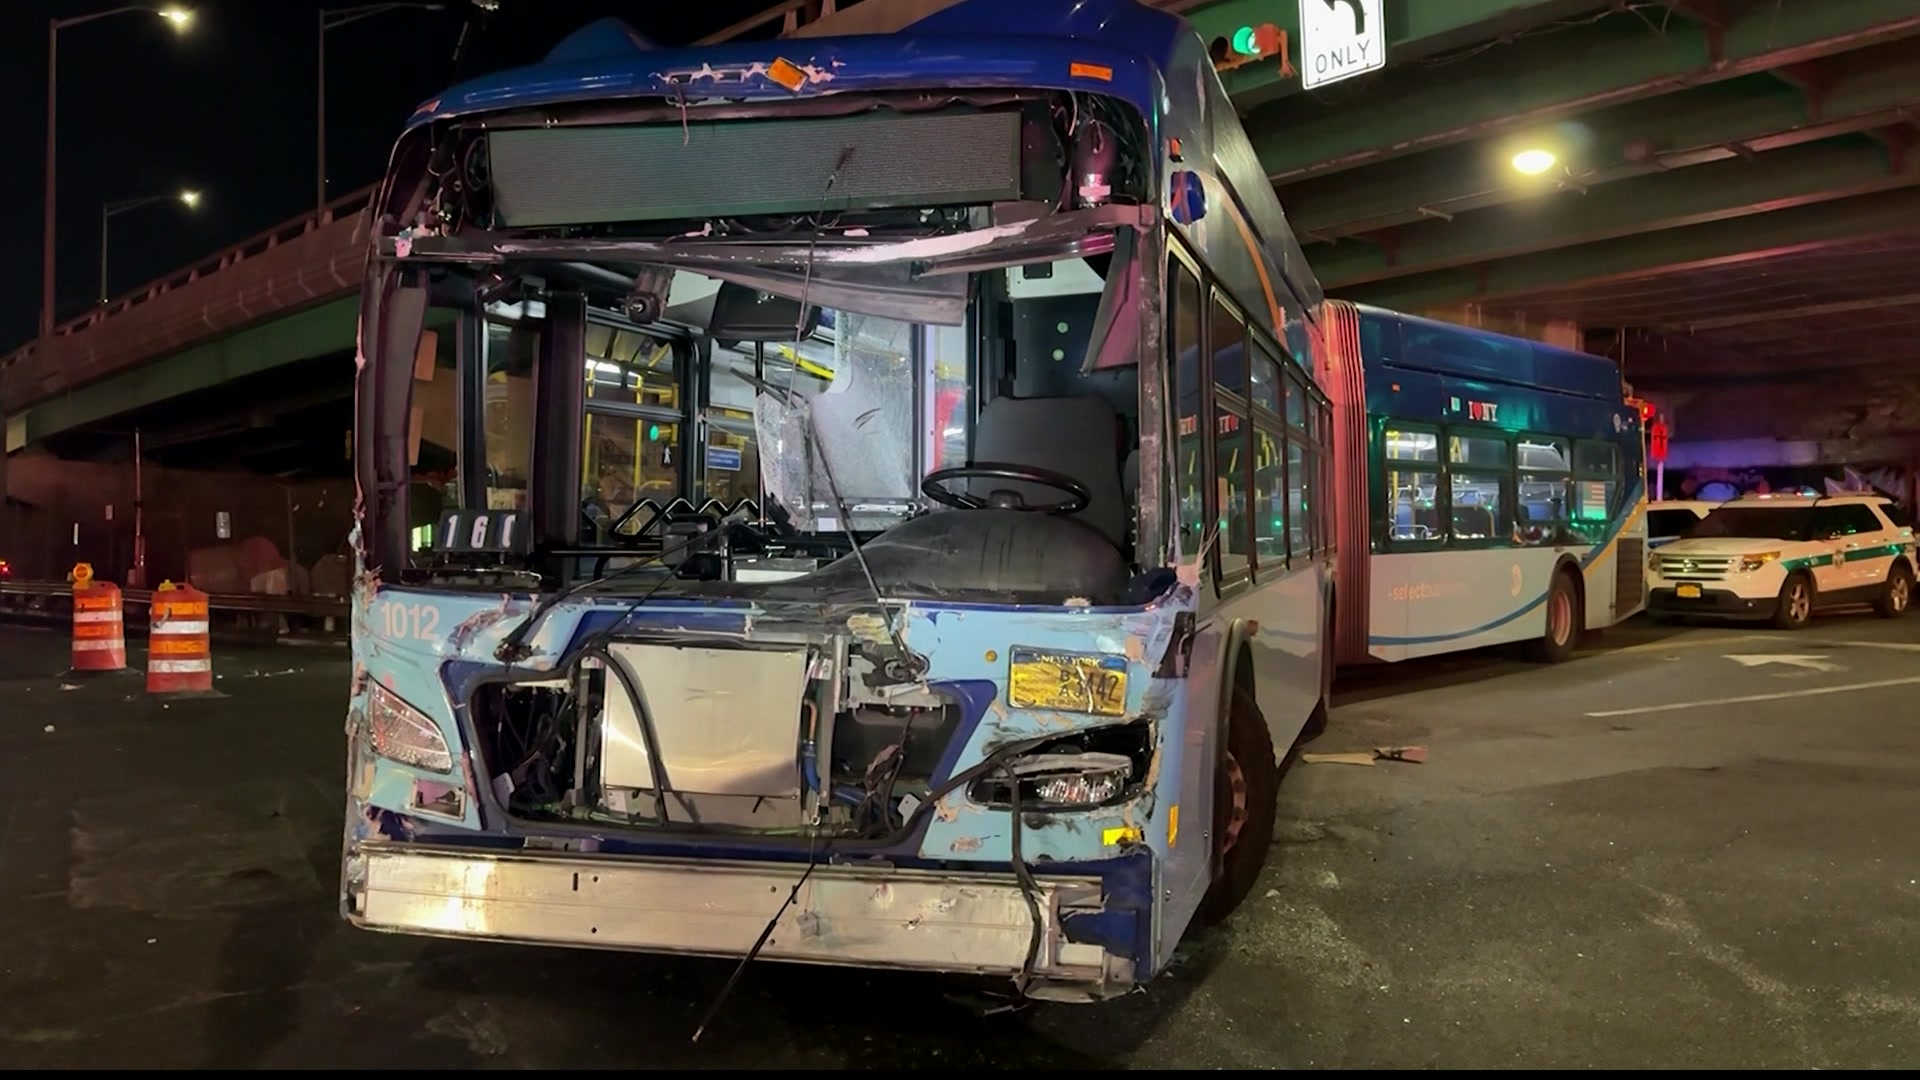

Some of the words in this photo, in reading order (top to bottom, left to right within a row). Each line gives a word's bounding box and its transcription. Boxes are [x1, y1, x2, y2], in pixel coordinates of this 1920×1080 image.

[1315, 39, 1370, 74] ONLY
[380, 601, 440, 641] 1012
[1041, 655, 1069, 664] NEW
[1071, 656, 1100, 667] YORK
